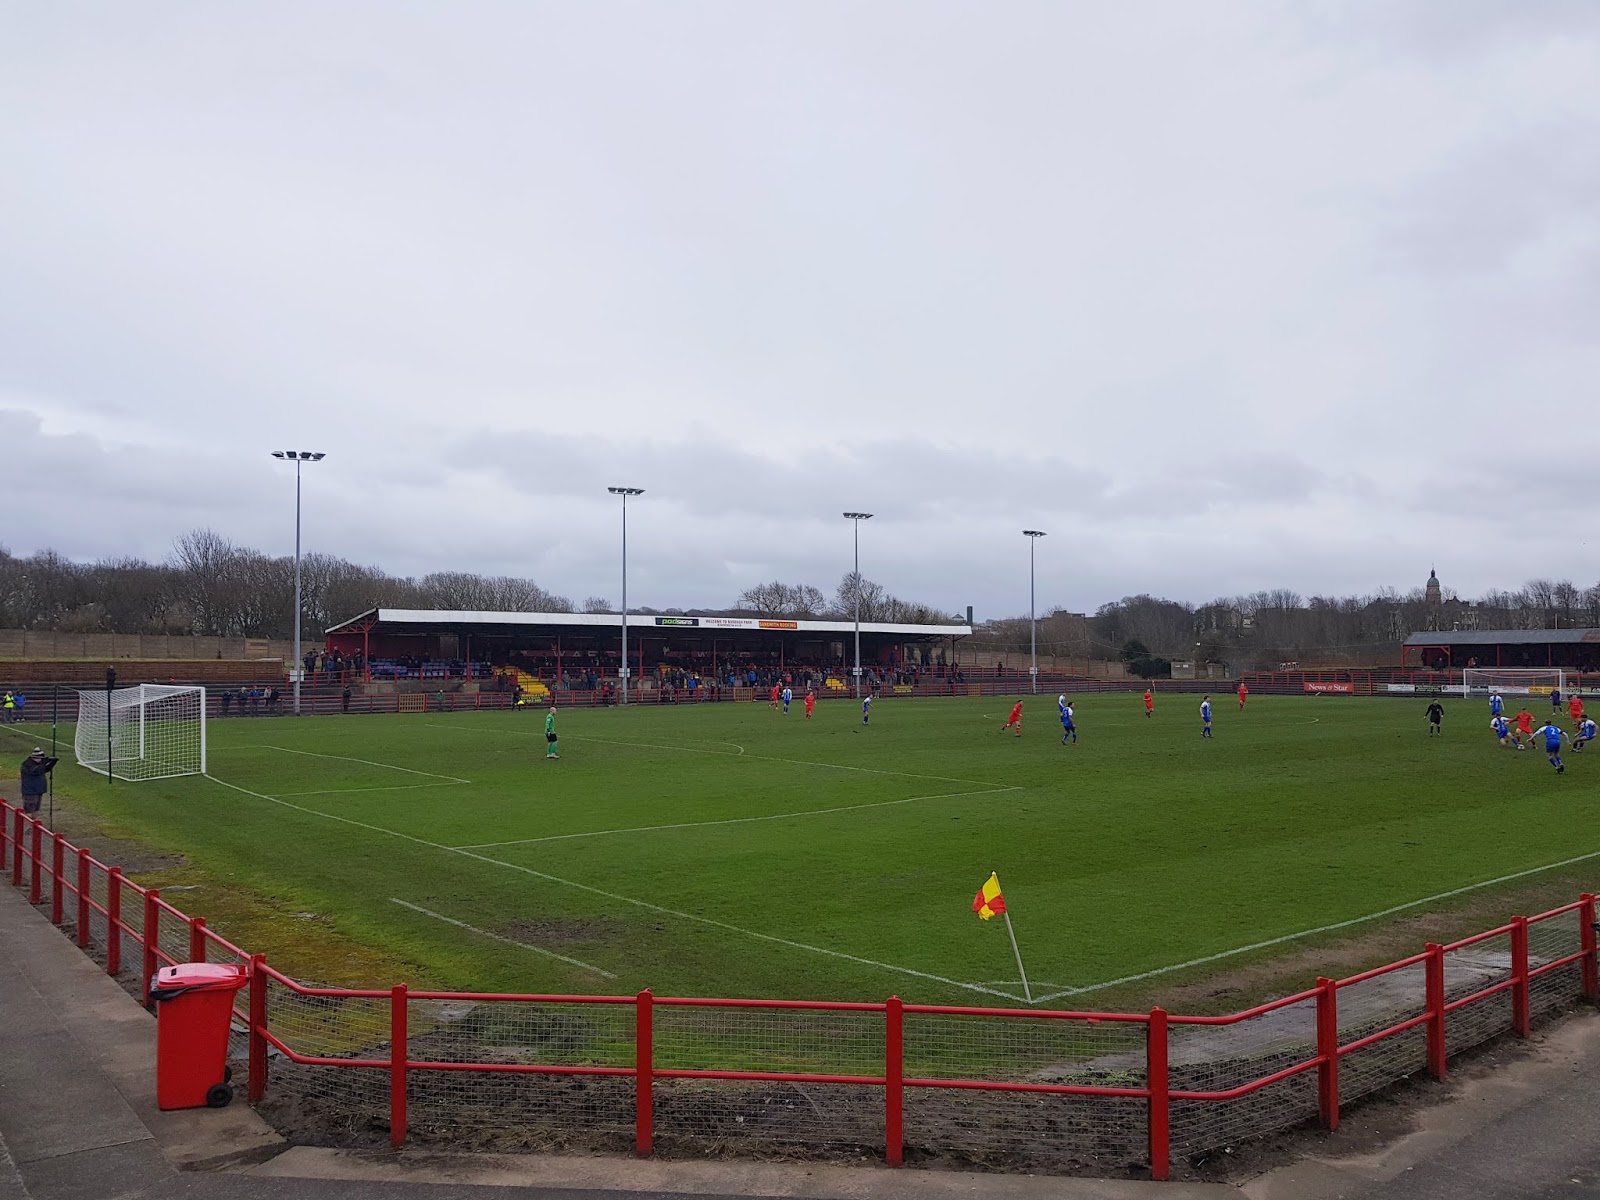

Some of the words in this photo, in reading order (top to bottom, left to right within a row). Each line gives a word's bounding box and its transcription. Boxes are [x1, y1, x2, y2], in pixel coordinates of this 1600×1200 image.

[1308, 683, 1327, 691] News
[1333, 683, 1349, 691] Star
[1550, 727, 1556, 735] 2
